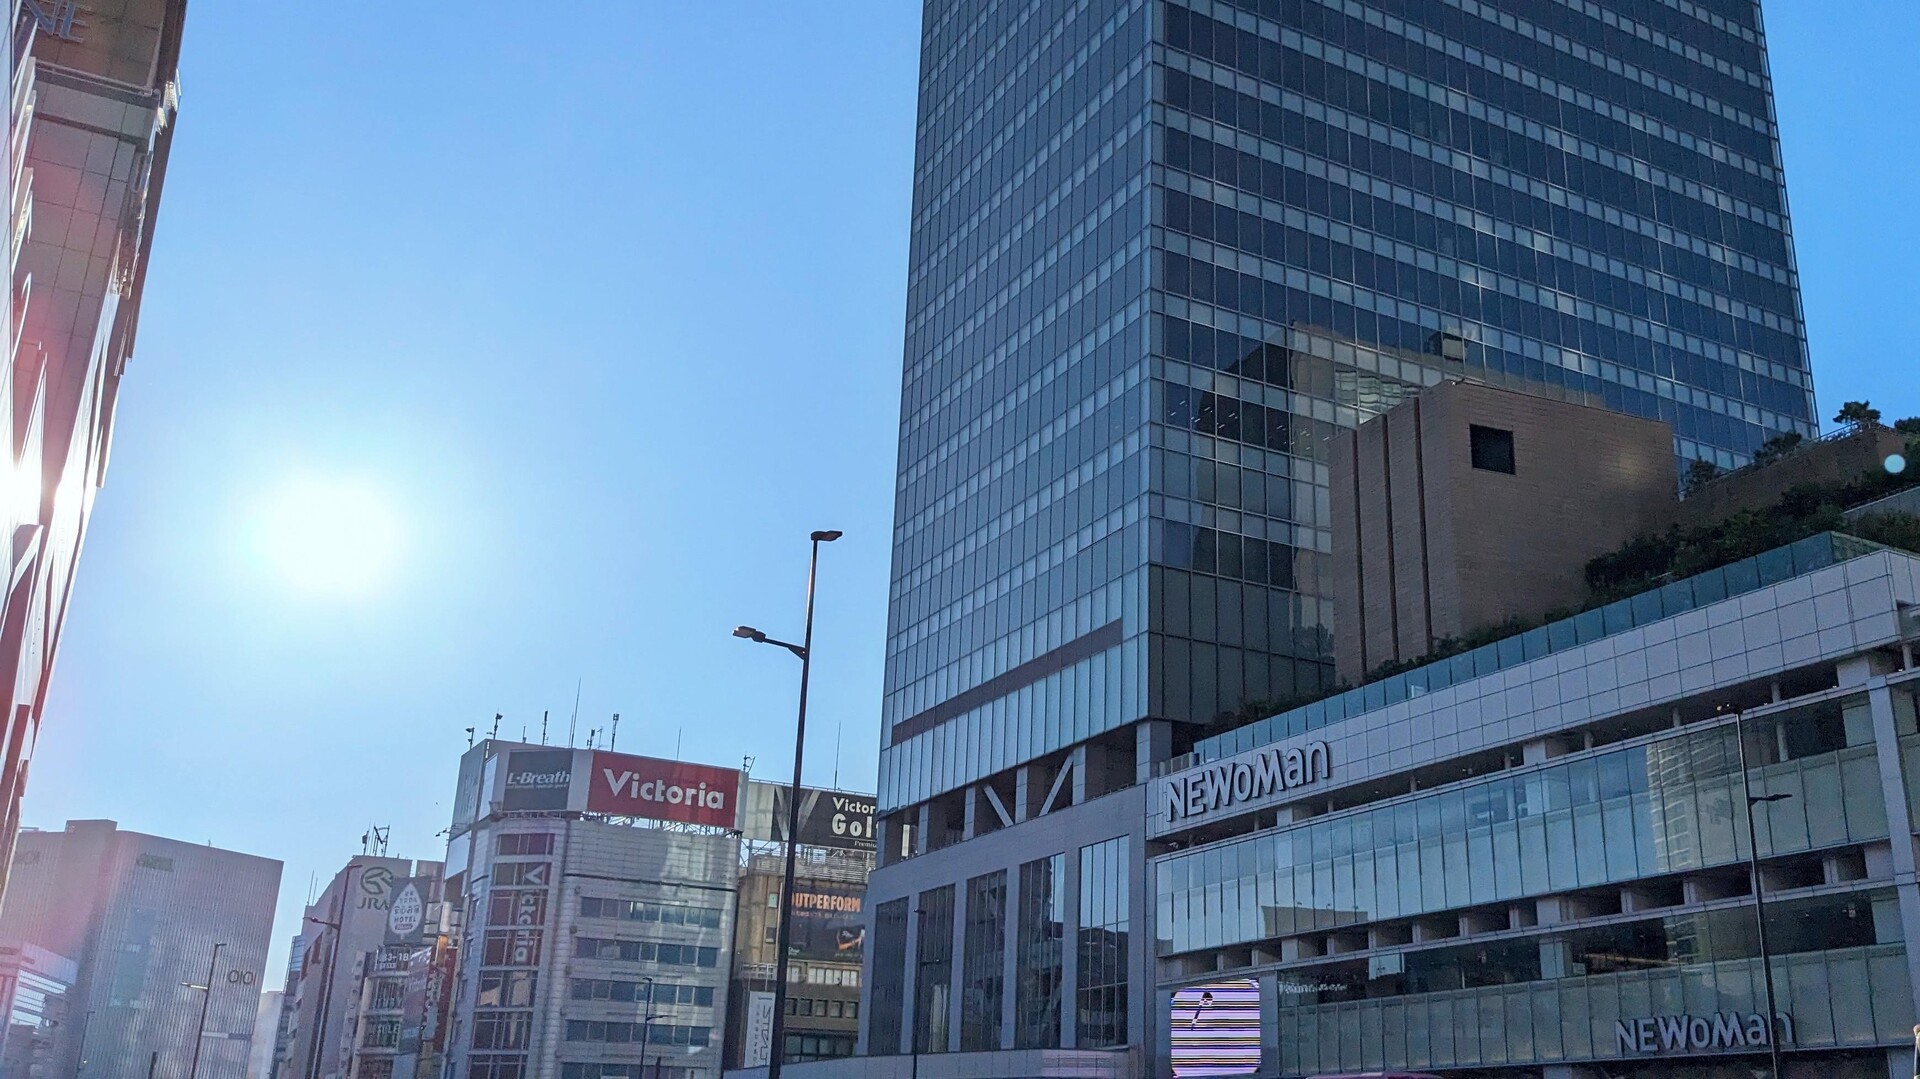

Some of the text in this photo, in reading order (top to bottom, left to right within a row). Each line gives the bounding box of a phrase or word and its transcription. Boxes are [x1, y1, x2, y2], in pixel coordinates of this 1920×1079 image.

[506, 770, 571, 785] L-Breath
[603, 768, 725, 810] Victoria
[1165, 740, 1330, 822] NEWoMan
[831, 813, 878, 838] Gol
[1614, 1010, 1794, 1053] NEWoMan
